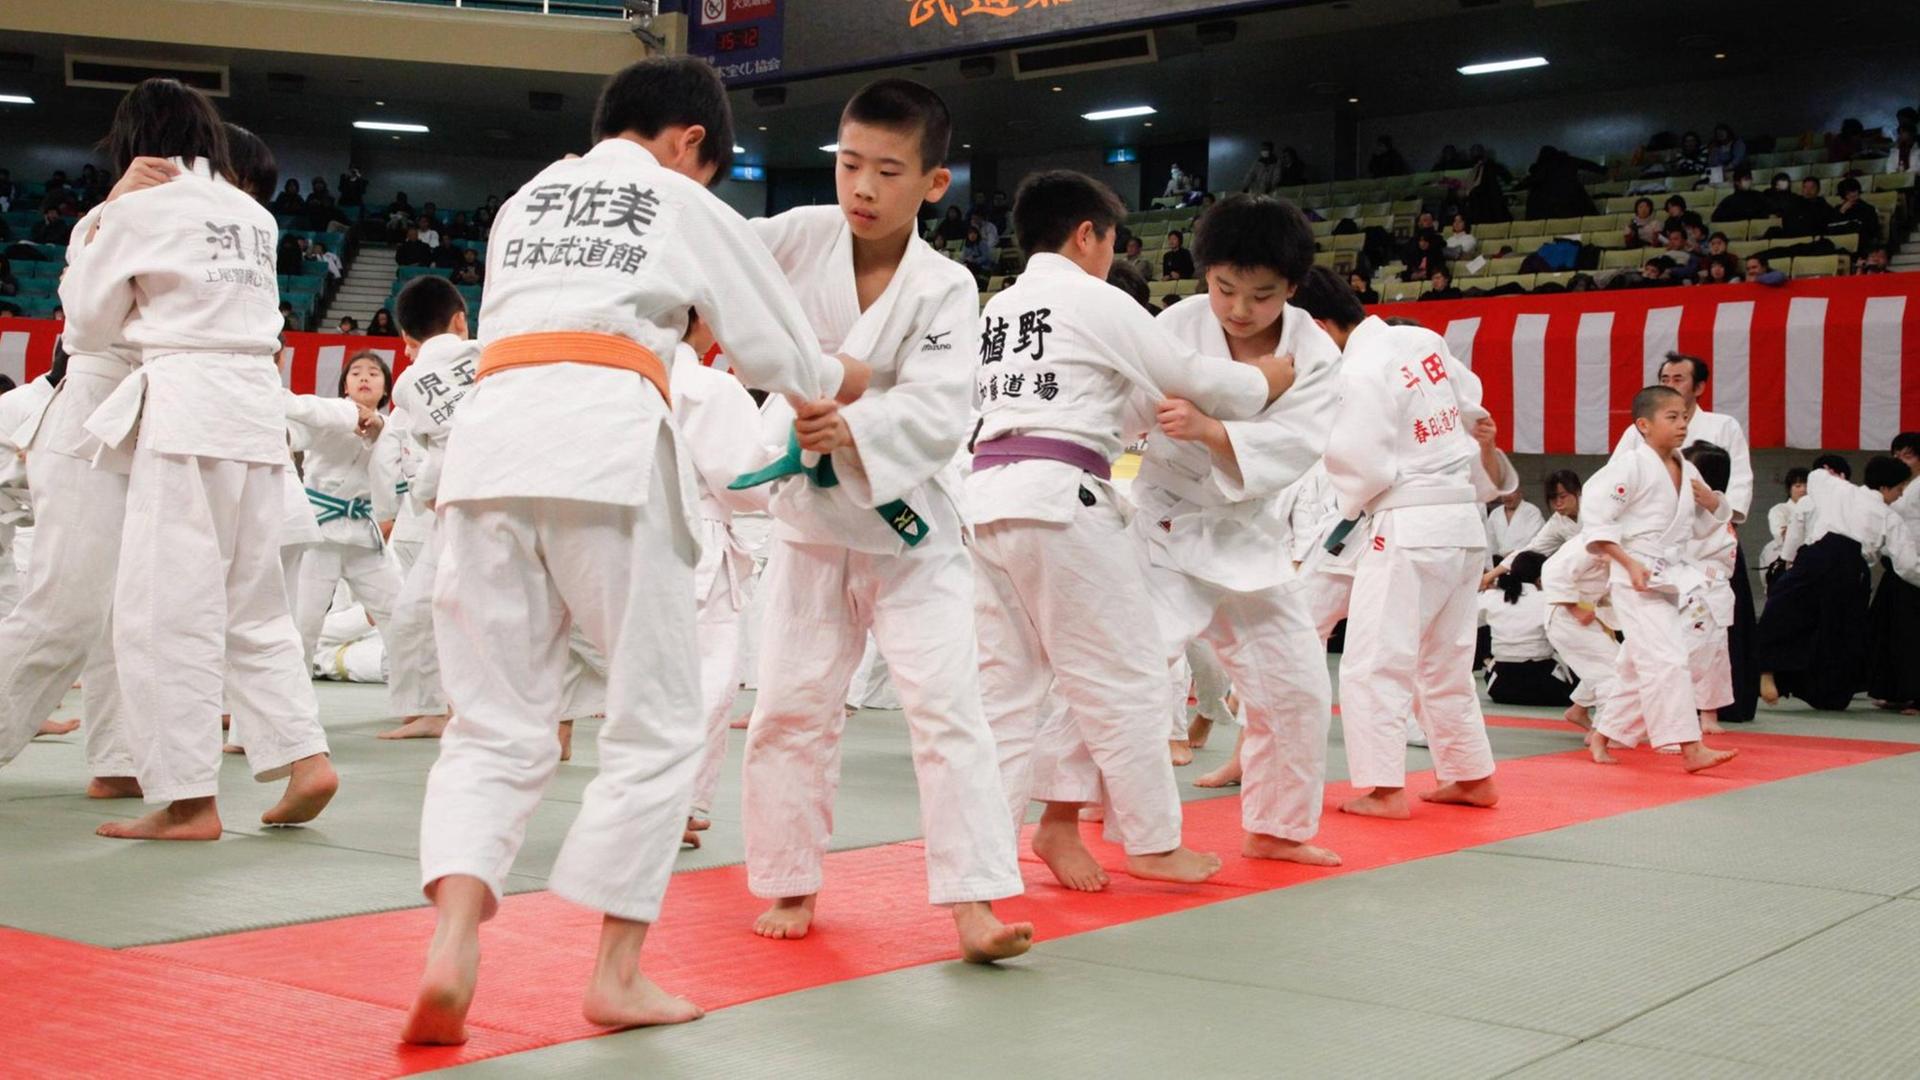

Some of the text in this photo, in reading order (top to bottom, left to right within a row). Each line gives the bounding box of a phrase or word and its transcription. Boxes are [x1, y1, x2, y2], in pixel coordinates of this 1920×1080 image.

[526, 180, 660, 236] 宇佐美
[502, 235, 648, 275] 日本武道館
[414, 360, 476, 406] 児玉
